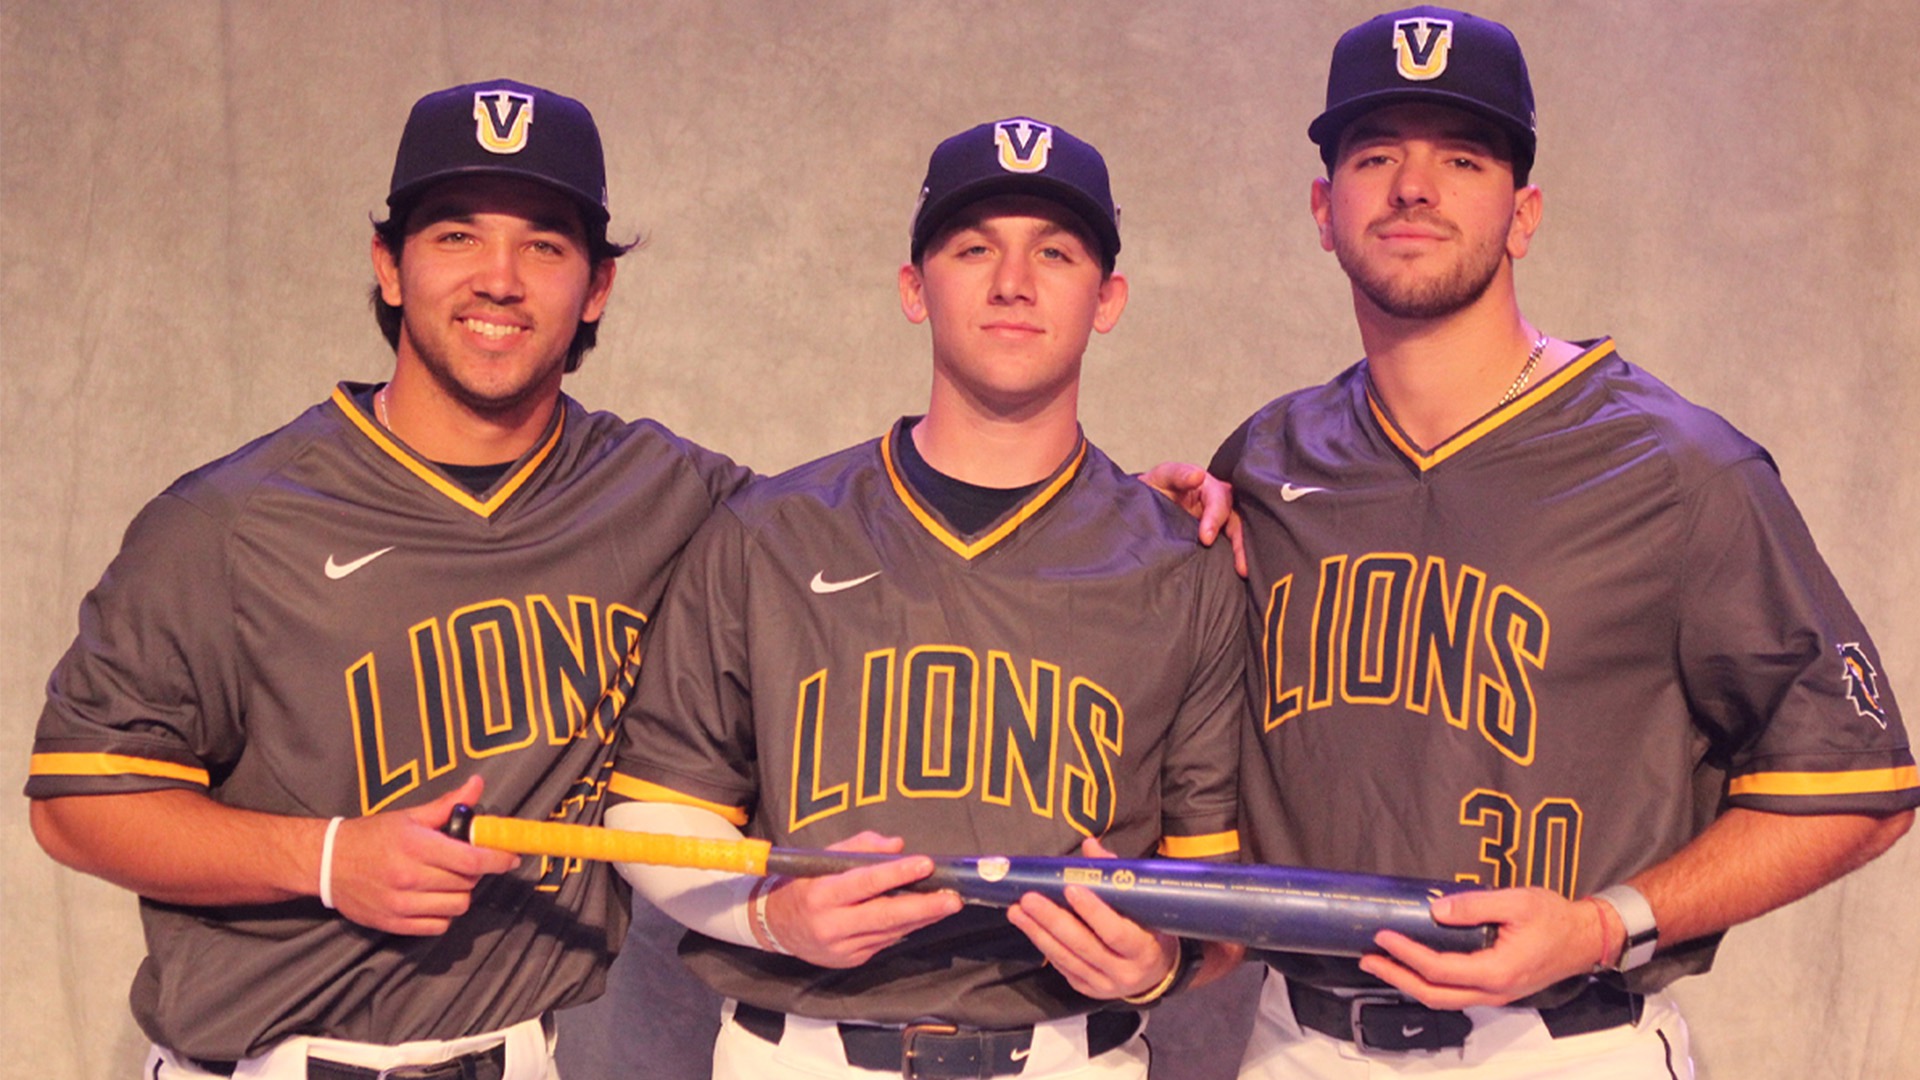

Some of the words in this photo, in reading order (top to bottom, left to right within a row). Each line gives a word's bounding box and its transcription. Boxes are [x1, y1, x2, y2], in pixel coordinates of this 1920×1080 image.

[788, 644, 1124, 838] LIONS
[1263, 552, 1549, 766] LIONS
[1455, 788, 1583, 901] 30
